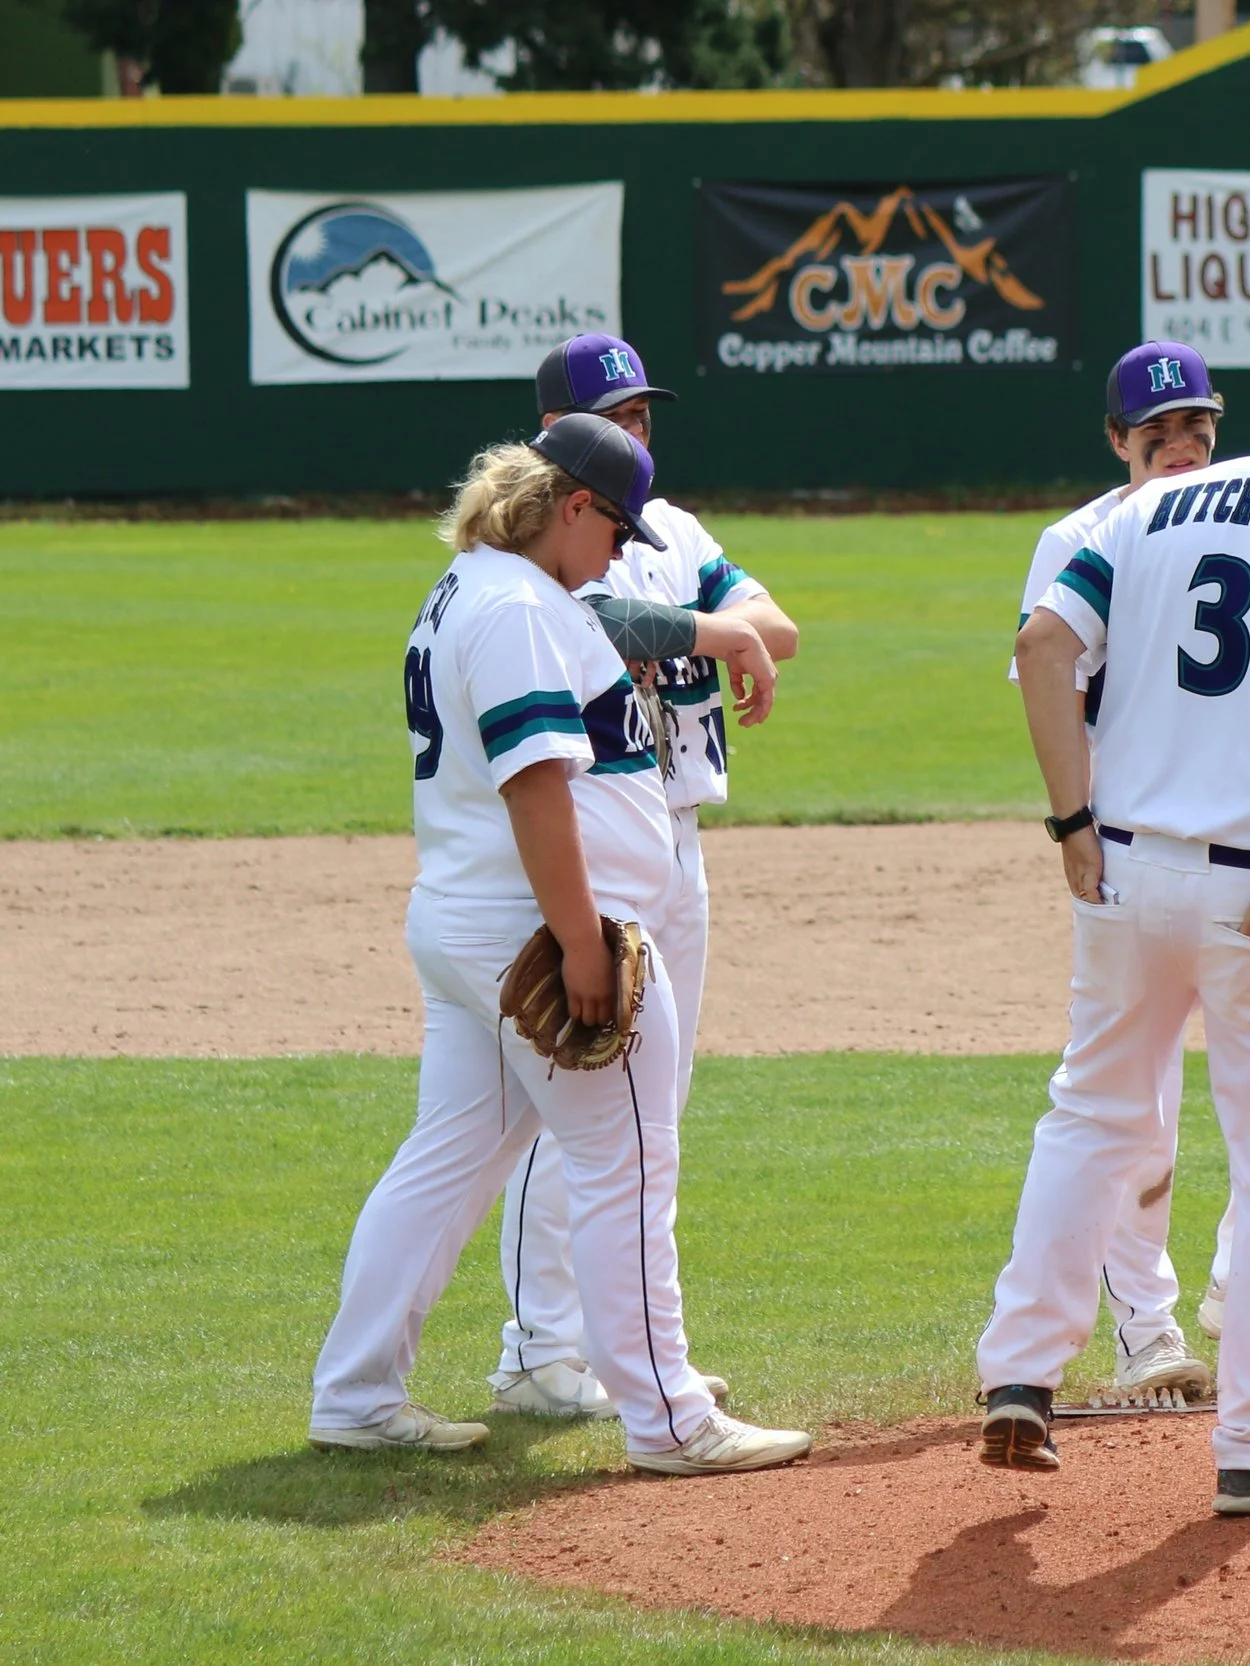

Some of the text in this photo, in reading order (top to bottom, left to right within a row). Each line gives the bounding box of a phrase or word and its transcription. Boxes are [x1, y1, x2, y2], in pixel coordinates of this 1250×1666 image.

[0, 227, 174, 327] UERS
[789, 252, 966, 332] CMC
[303, 297, 607, 333] Cabinet Peaks
[0, 333, 174, 361] MARKETS
[718, 328, 1058, 373] Copper Mountain Coffee
